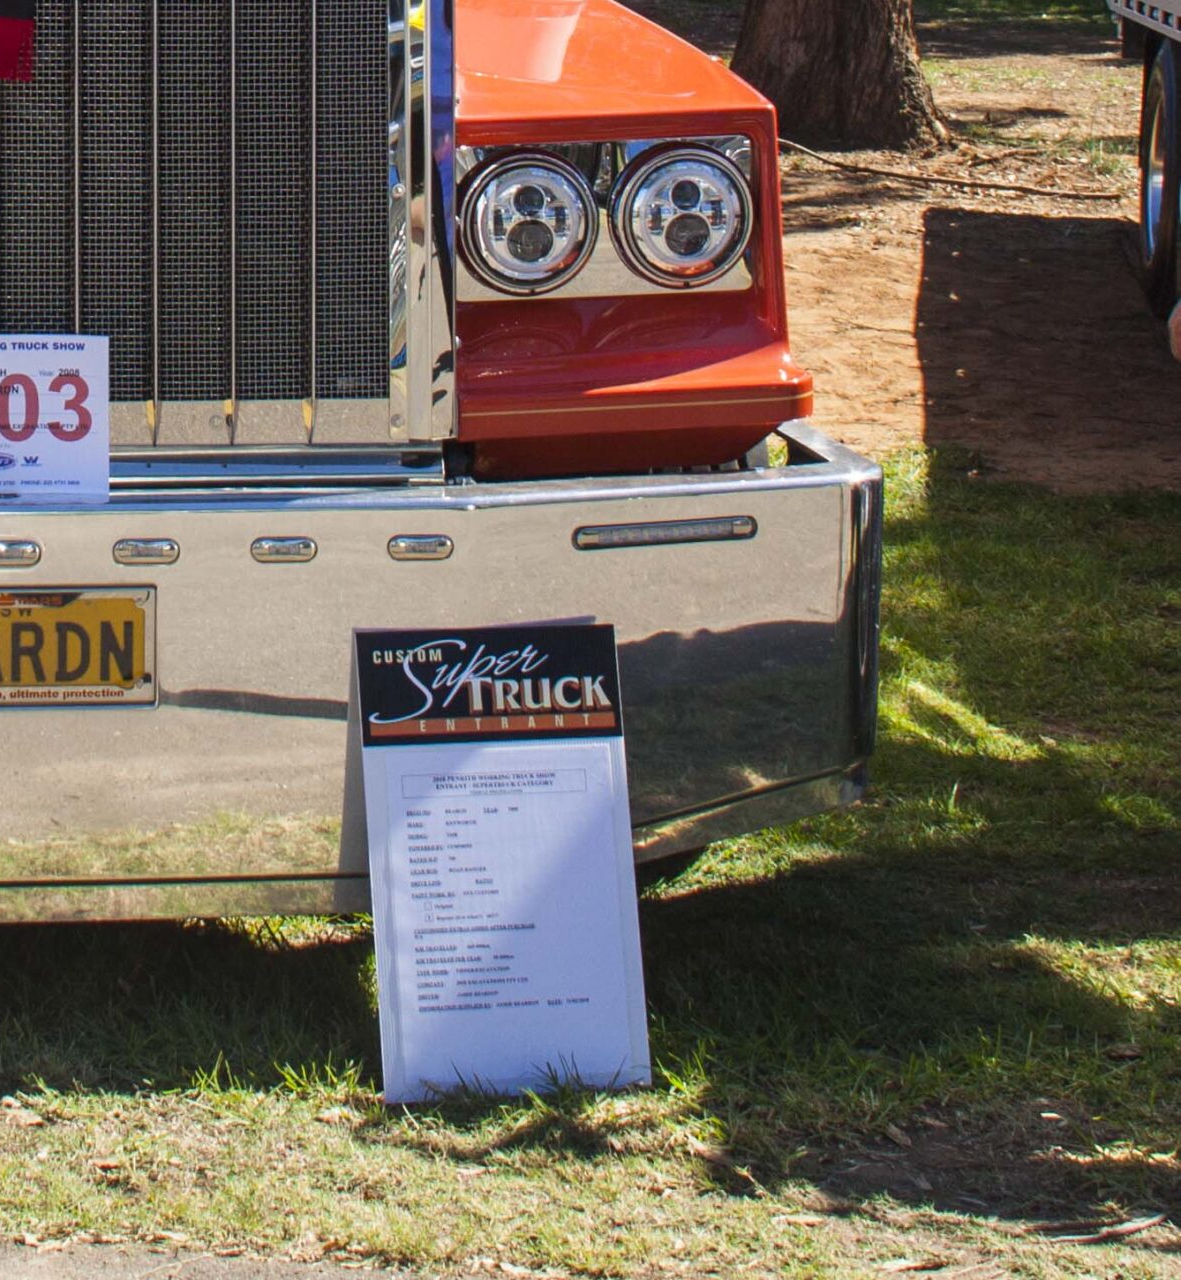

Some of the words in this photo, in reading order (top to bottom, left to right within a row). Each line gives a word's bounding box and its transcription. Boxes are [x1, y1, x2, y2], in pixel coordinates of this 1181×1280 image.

[11, 341, 49, 351] TRUCK
[52, 341, 85, 351] SHOW
[372, 647, 443, 665] CUSTOM
[369, 638, 550, 724] Super
[9, 689, 59, 699] ultimate
[62, 689, 125, 701] protection
[464, 675, 614, 716] TRUCK
[419, 713, 591, 733] ENTRANT
